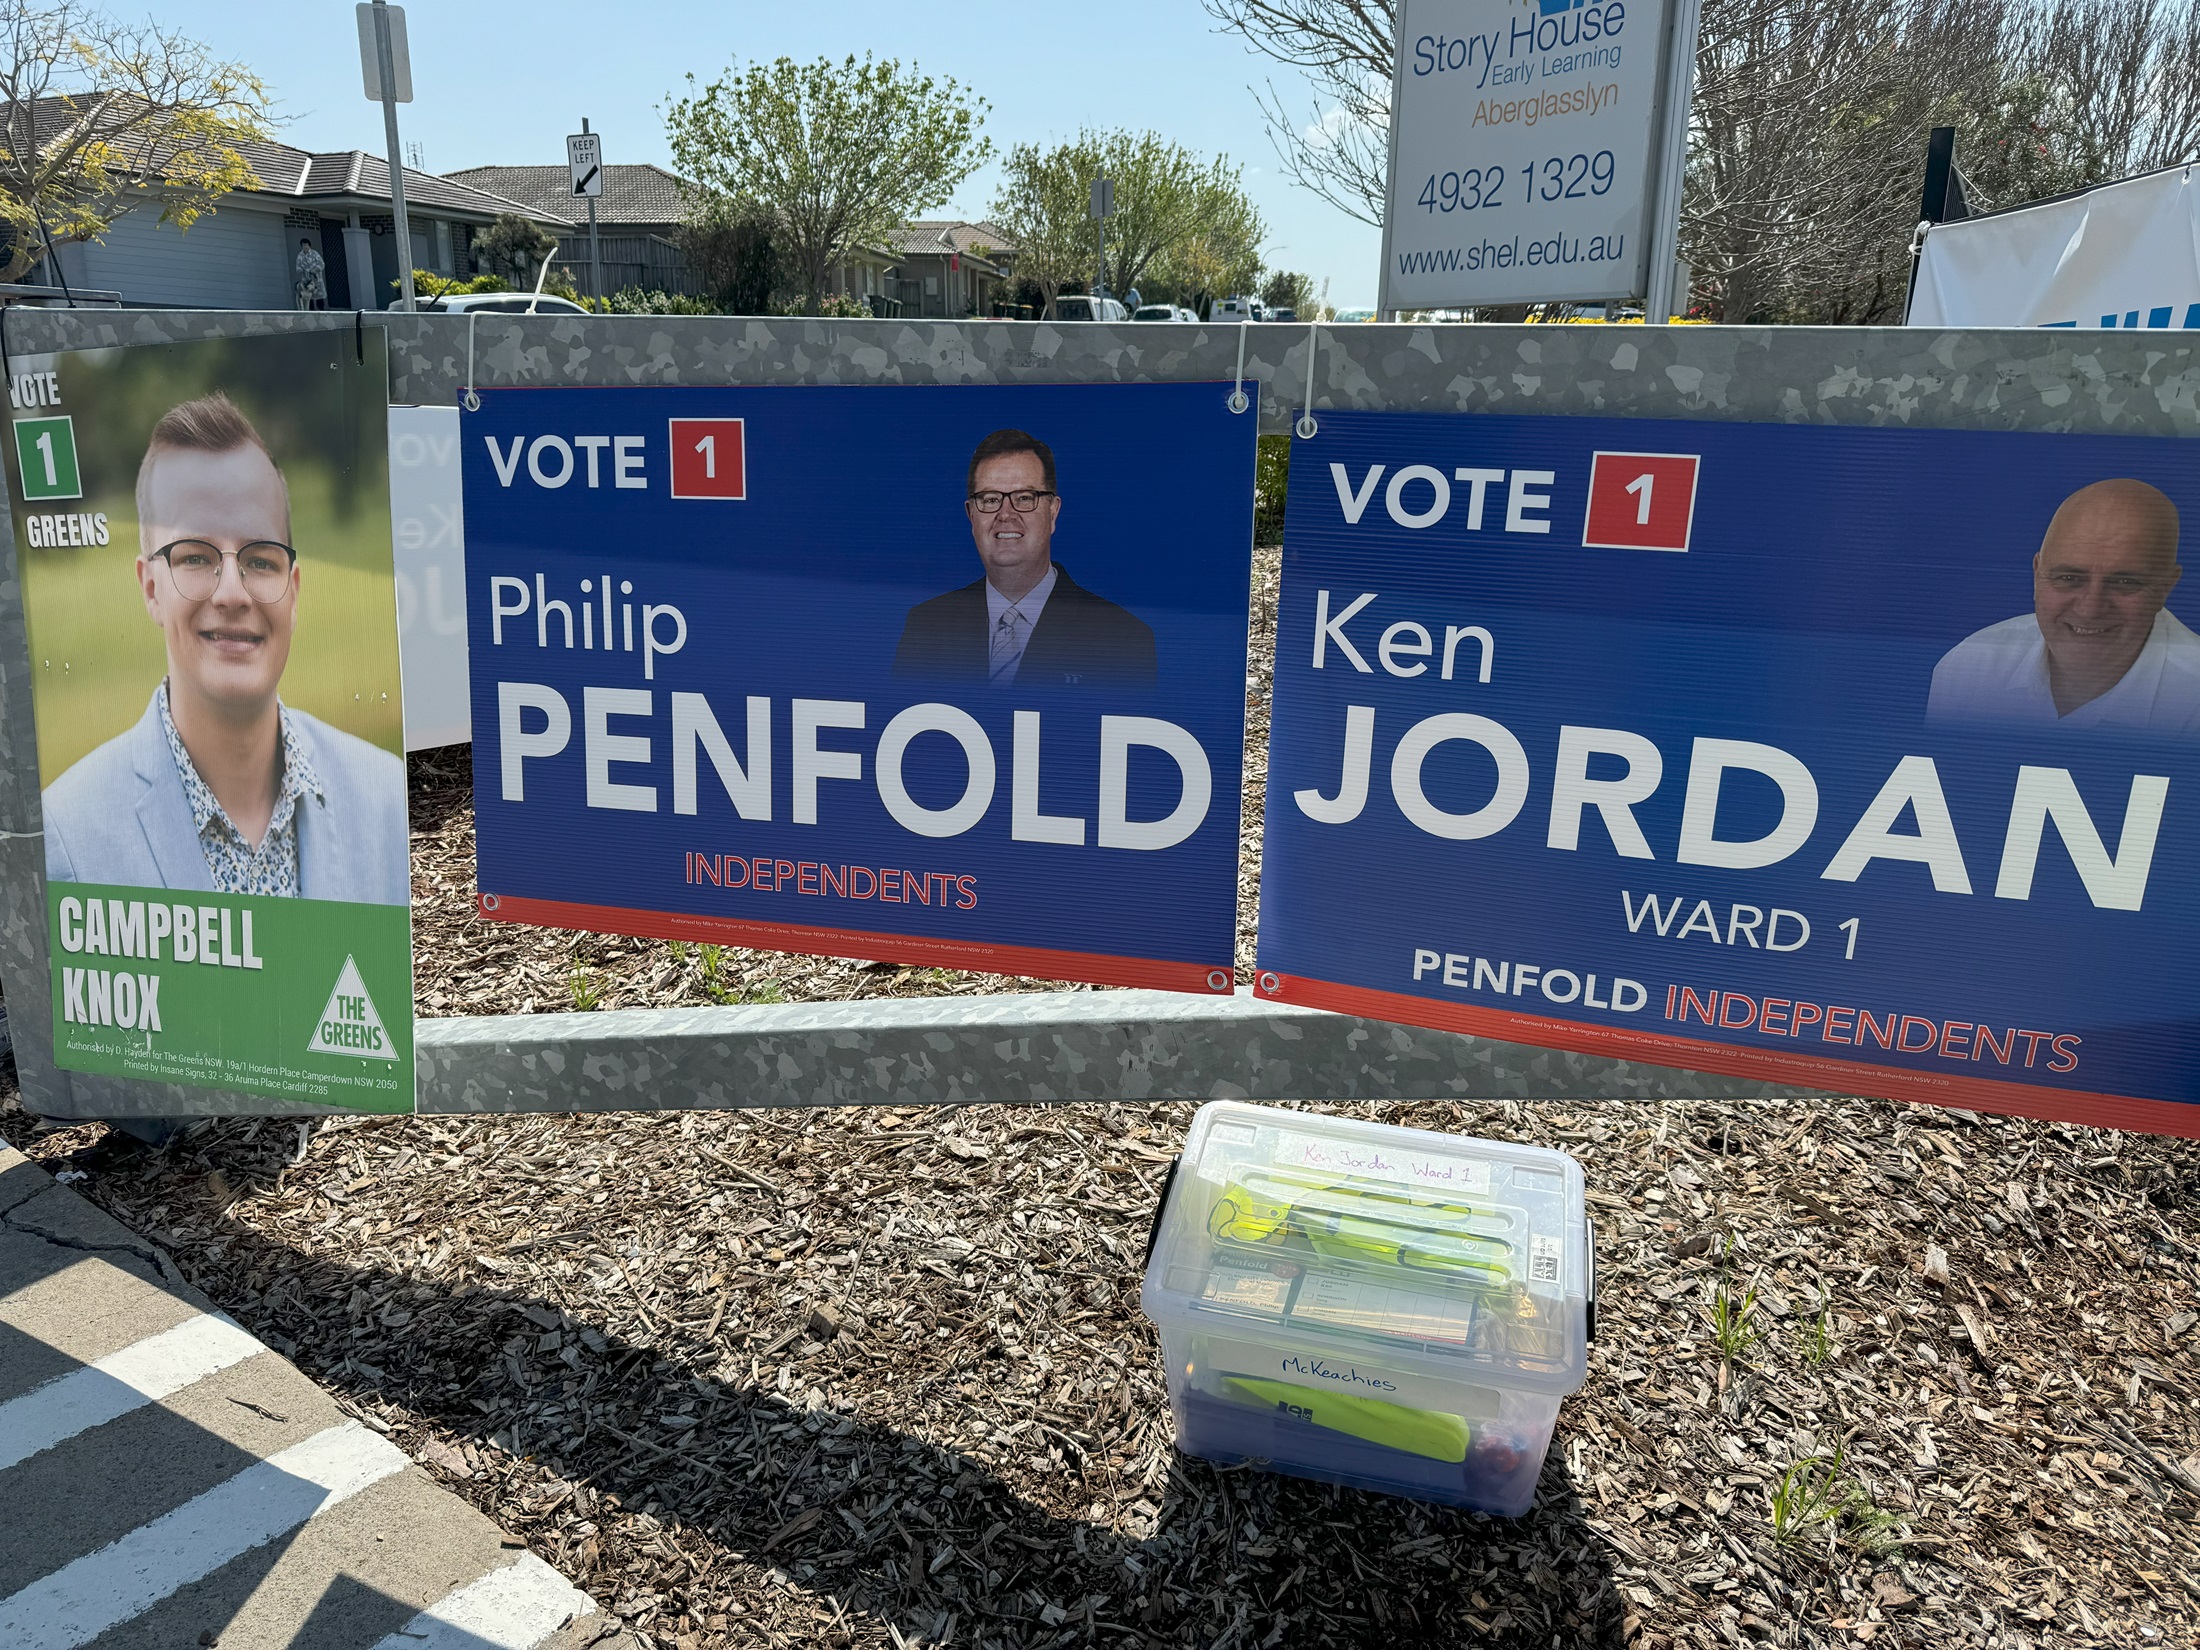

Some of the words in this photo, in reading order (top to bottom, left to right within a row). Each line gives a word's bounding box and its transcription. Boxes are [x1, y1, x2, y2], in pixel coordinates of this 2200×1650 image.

[1413, 31, 1500, 89] Story
[1509, 1, 1625, 58] House
[1492, 60, 1535, 86] Early
[1542, 45, 1622, 78] Learning
[1471, 81, 1618, 128] Aberglasslyn
[572, 139, 594, 151] KEEP
[574, 152, 595, 164] LEFT
[1418, 165, 1505, 214] 4932
[1521, 150, 1615, 203] 1329
[1399, 231, 1624, 275] www.shel.edu.au
[9, 371, 62, 408] VOTE
[35, 431, 57, 486] 1
[484, 435, 648, 489] VOTE
[695, 435, 716, 479] 1
[1329, 462, 1555, 535] VOTE
[1624, 473, 1656, 525] 1
[26, 512, 110, 548] GREENS
[490, 573, 688, 680] Philip
[1311, 590, 1495, 684] Ken
[497, 682, 1213, 851] PENFOLD
[1293, 705, 2171, 913] JORDAN
[685, 852, 978, 911] INDEPENDENTS
[59, 896, 263, 970] CAMPBELL
[1621, 890, 1811, 954] WARD
[1837, 917, 1861, 961] 1
[62, 966, 162, 1032] KNOX
[336, 994, 365, 1022] THE
[1412, 949, 1648, 1014] PENFOLD
[1664, 984, 2082, 1073] INDEPENDENTS
[321, 1021, 382, 1051] GREENS
[1510, 1017, 1543, 1028] Authorised
[1569, 1026, 1600, 1036] Yarrington
[1611, 1033, 1635, 1042] Thomas
[1636, 1037, 1652, 1045] Coke
[1674, 1042, 1702, 1052] Thornton
[1740, 1052, 1763, 1061] Printed
[1774, 1057, 1815, 1068] Industroquip
[1826, 1064, 1854, 1074] Gardiner
[1877, 1070, 1912, 1081] Rutherford
[1913, 1076, 1931, 1084] NSW
[1932, 1078, 1949, 1086] 2320
[67, 1041, 104, 1052] Authorised
[106, 1044, 114, 1055] by
[116, 1046, 123, 1055] D.
[124, 1047, 150, 1059] Hayden
[152, 1050, 163, 1059] for
[164, 1051, 177, 1062] The
[179, 1053, 203, 1065] Greens
[205, 1056, 224, 1068] NSW.
[226, 1059, 246, 1071] 19a/1
[249, 1063, 278, 1075] Hordern
[280, 1067, 300, 1078] Place
[302, 1070, 352, 1085] Camperdown
[354, 1077, 373, 1087] NSW
[376, 1079, 397, 1090] 2050
[124, 1059, 148, 1071] Printed
[150, 1063, 159, 1073] by
[161, 1064, 184, 1075] Insane
[185, 1067, 206, 1079] Signs,
[208, 1070, 217, 1080] 32
[224, 1073, 233, 1082] 36
[235, 1074, 259, 1085] Aruma
[260, 1078, 281, 1089] Place
[282, 1081, 308, 1092] Cardiff
[309, 1084, 328, 1095] 2285
[1304, 1144, 1331, 1163] Ken
[1341, 1150, 1395, 1170] Jordan
[1412, 1162, 1452, 1179] Ward
[1461, 1167, 1473, 1182] 1
[1219, 1255, 1269, 1270] Penfold
[1282, 1357, 1397, 1391] McKeachies
